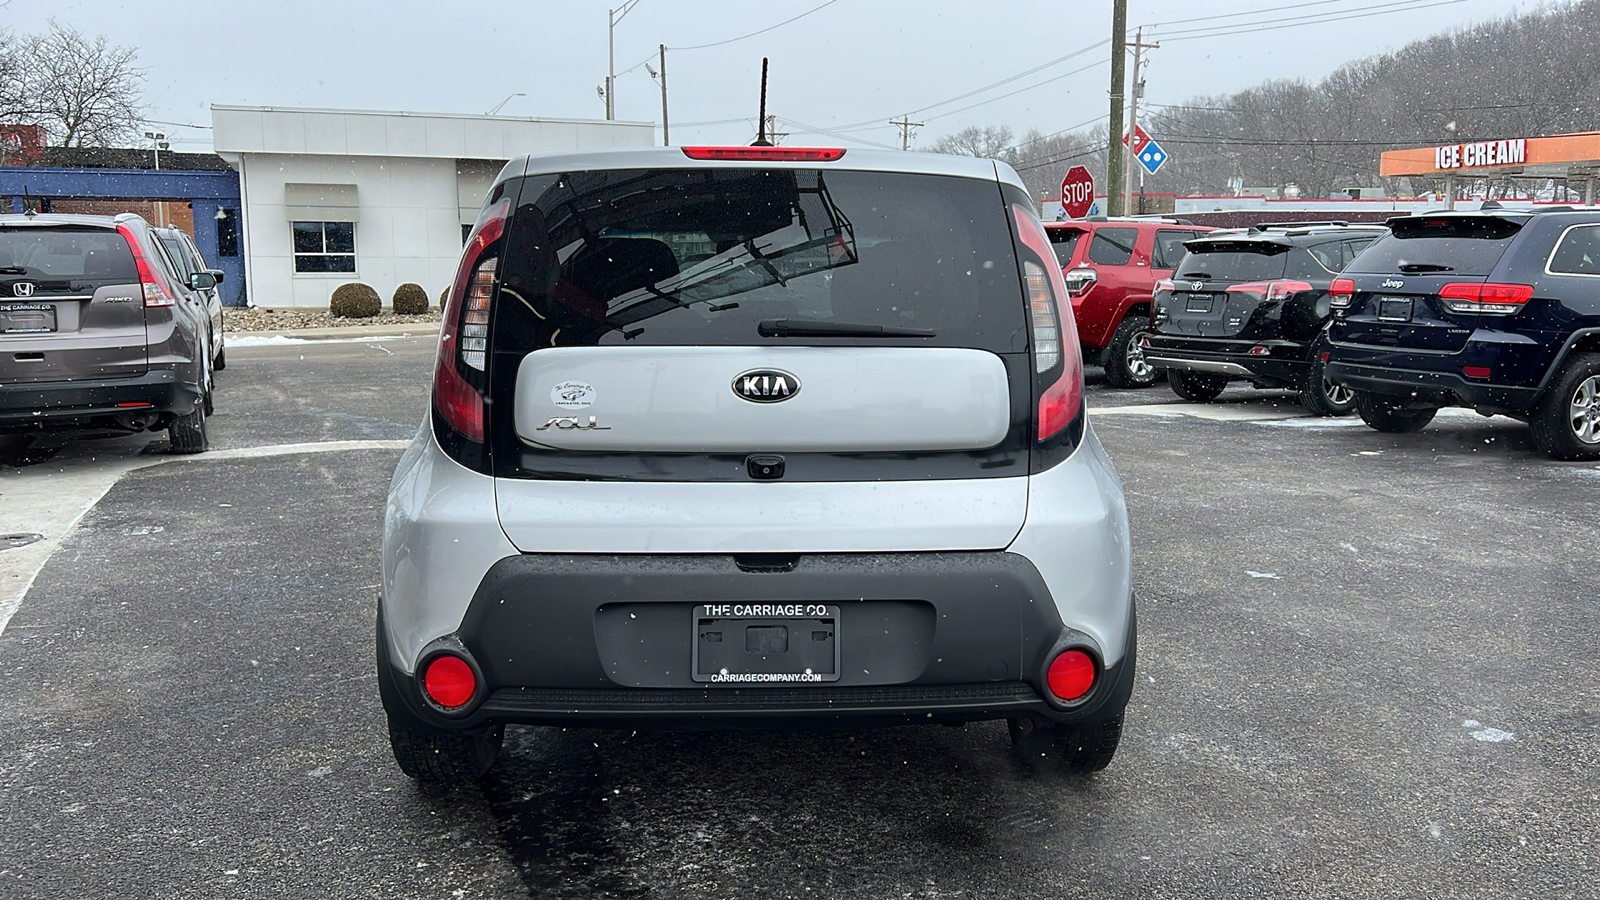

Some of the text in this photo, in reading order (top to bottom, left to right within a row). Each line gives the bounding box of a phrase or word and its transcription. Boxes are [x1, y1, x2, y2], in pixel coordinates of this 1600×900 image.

[1435, 138, 1526, 169] ICE CREAM
[1063, 181, 1092, 204] STOP
[1382, 278, 1404, 290] Jeep
[104, 296, 133, 304] AWD
[743, 376, 790, 396] KIA
[536, 415, 612, 431] SOUL
[703, 604, 829, 616] THE CARRIAGE CO.
[710, 673, 822, 683] CARRIAGECOMPANY.COM
